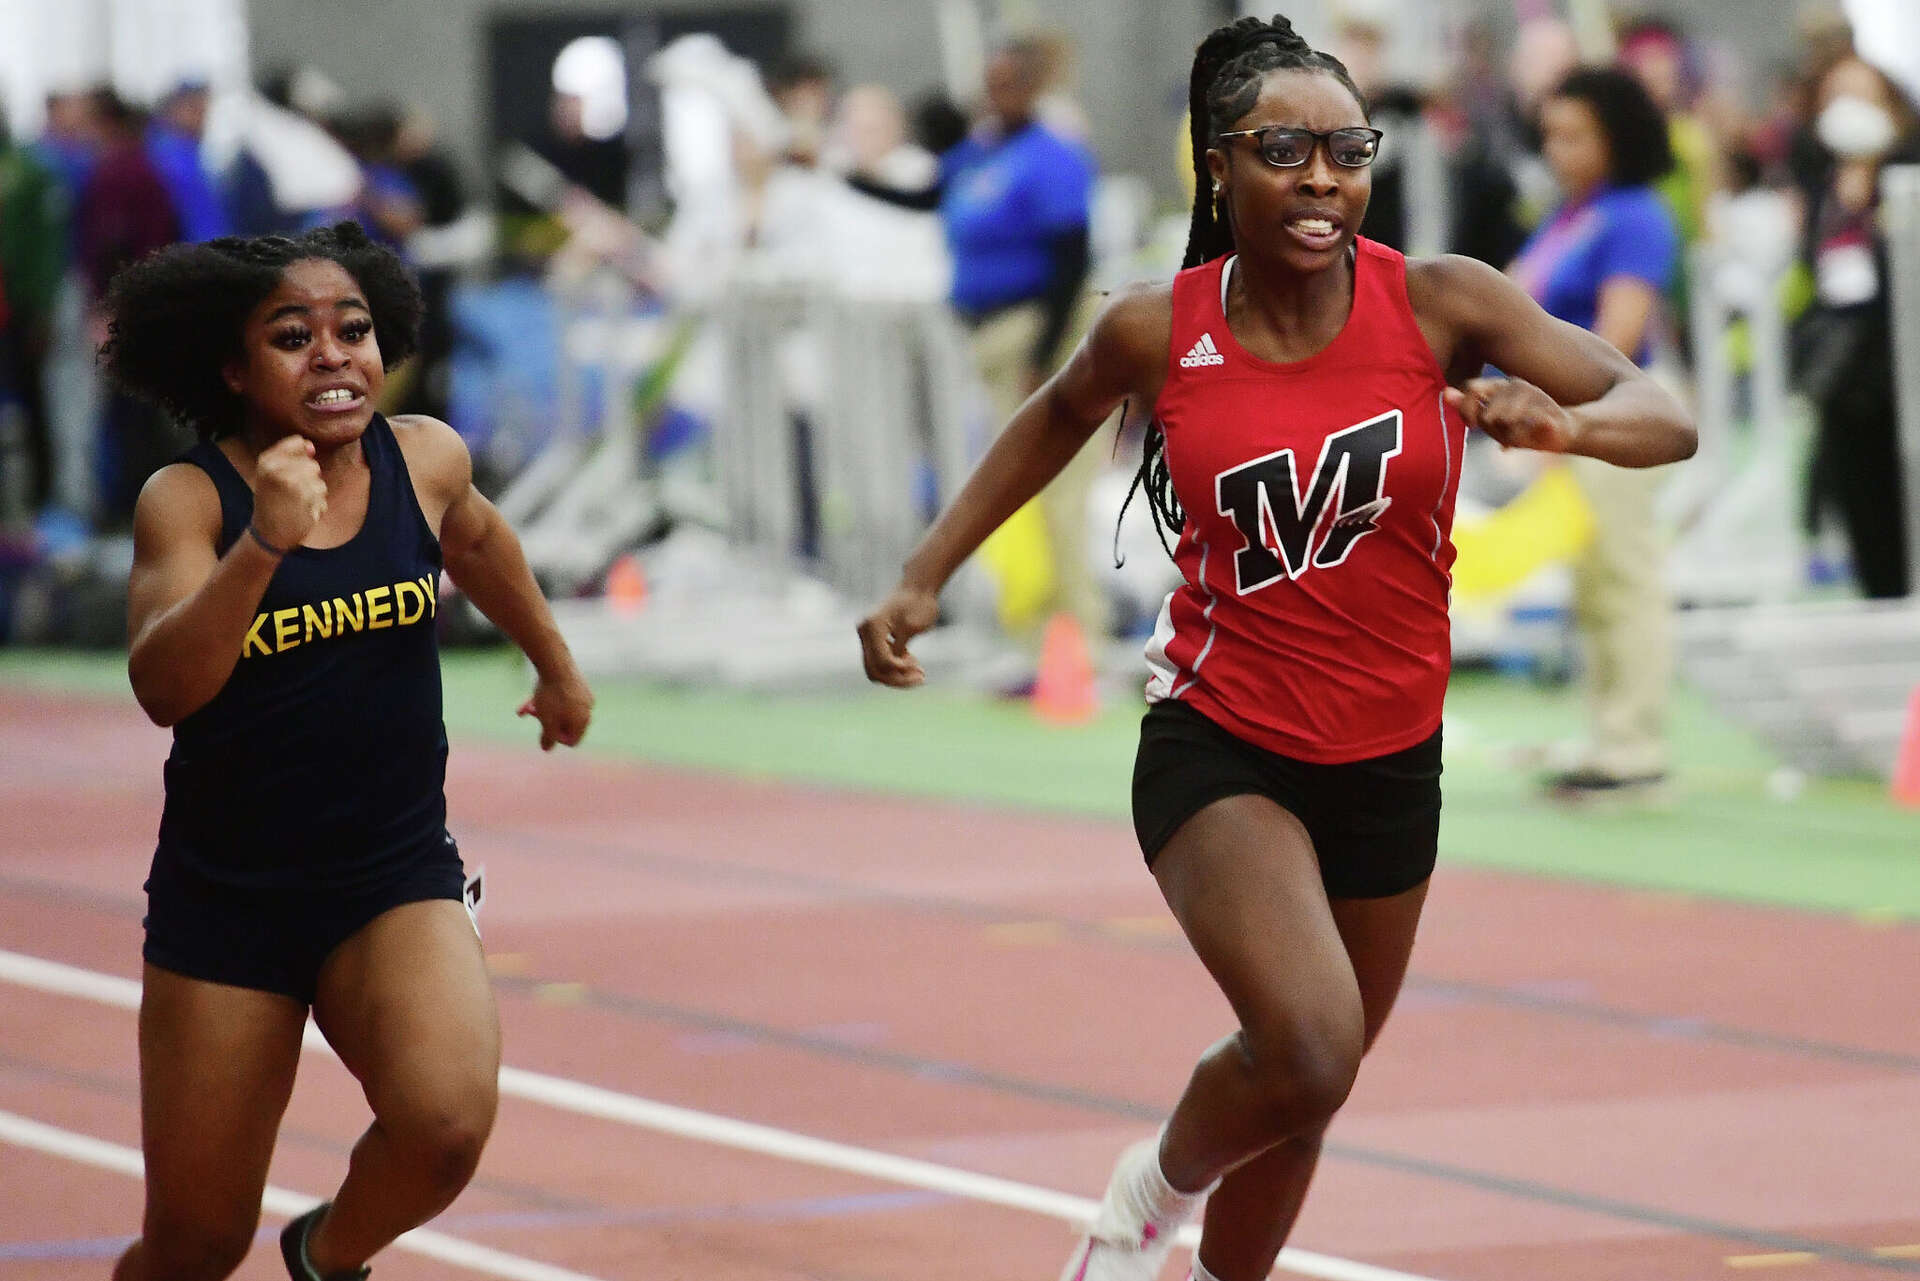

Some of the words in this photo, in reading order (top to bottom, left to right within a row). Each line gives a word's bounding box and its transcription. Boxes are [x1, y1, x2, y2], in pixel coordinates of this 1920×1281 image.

[1180, 354, 1224, 367] adidas
[1215, 409, 1402, 595] M
[243, 573, 436, 658] KENNEDY
